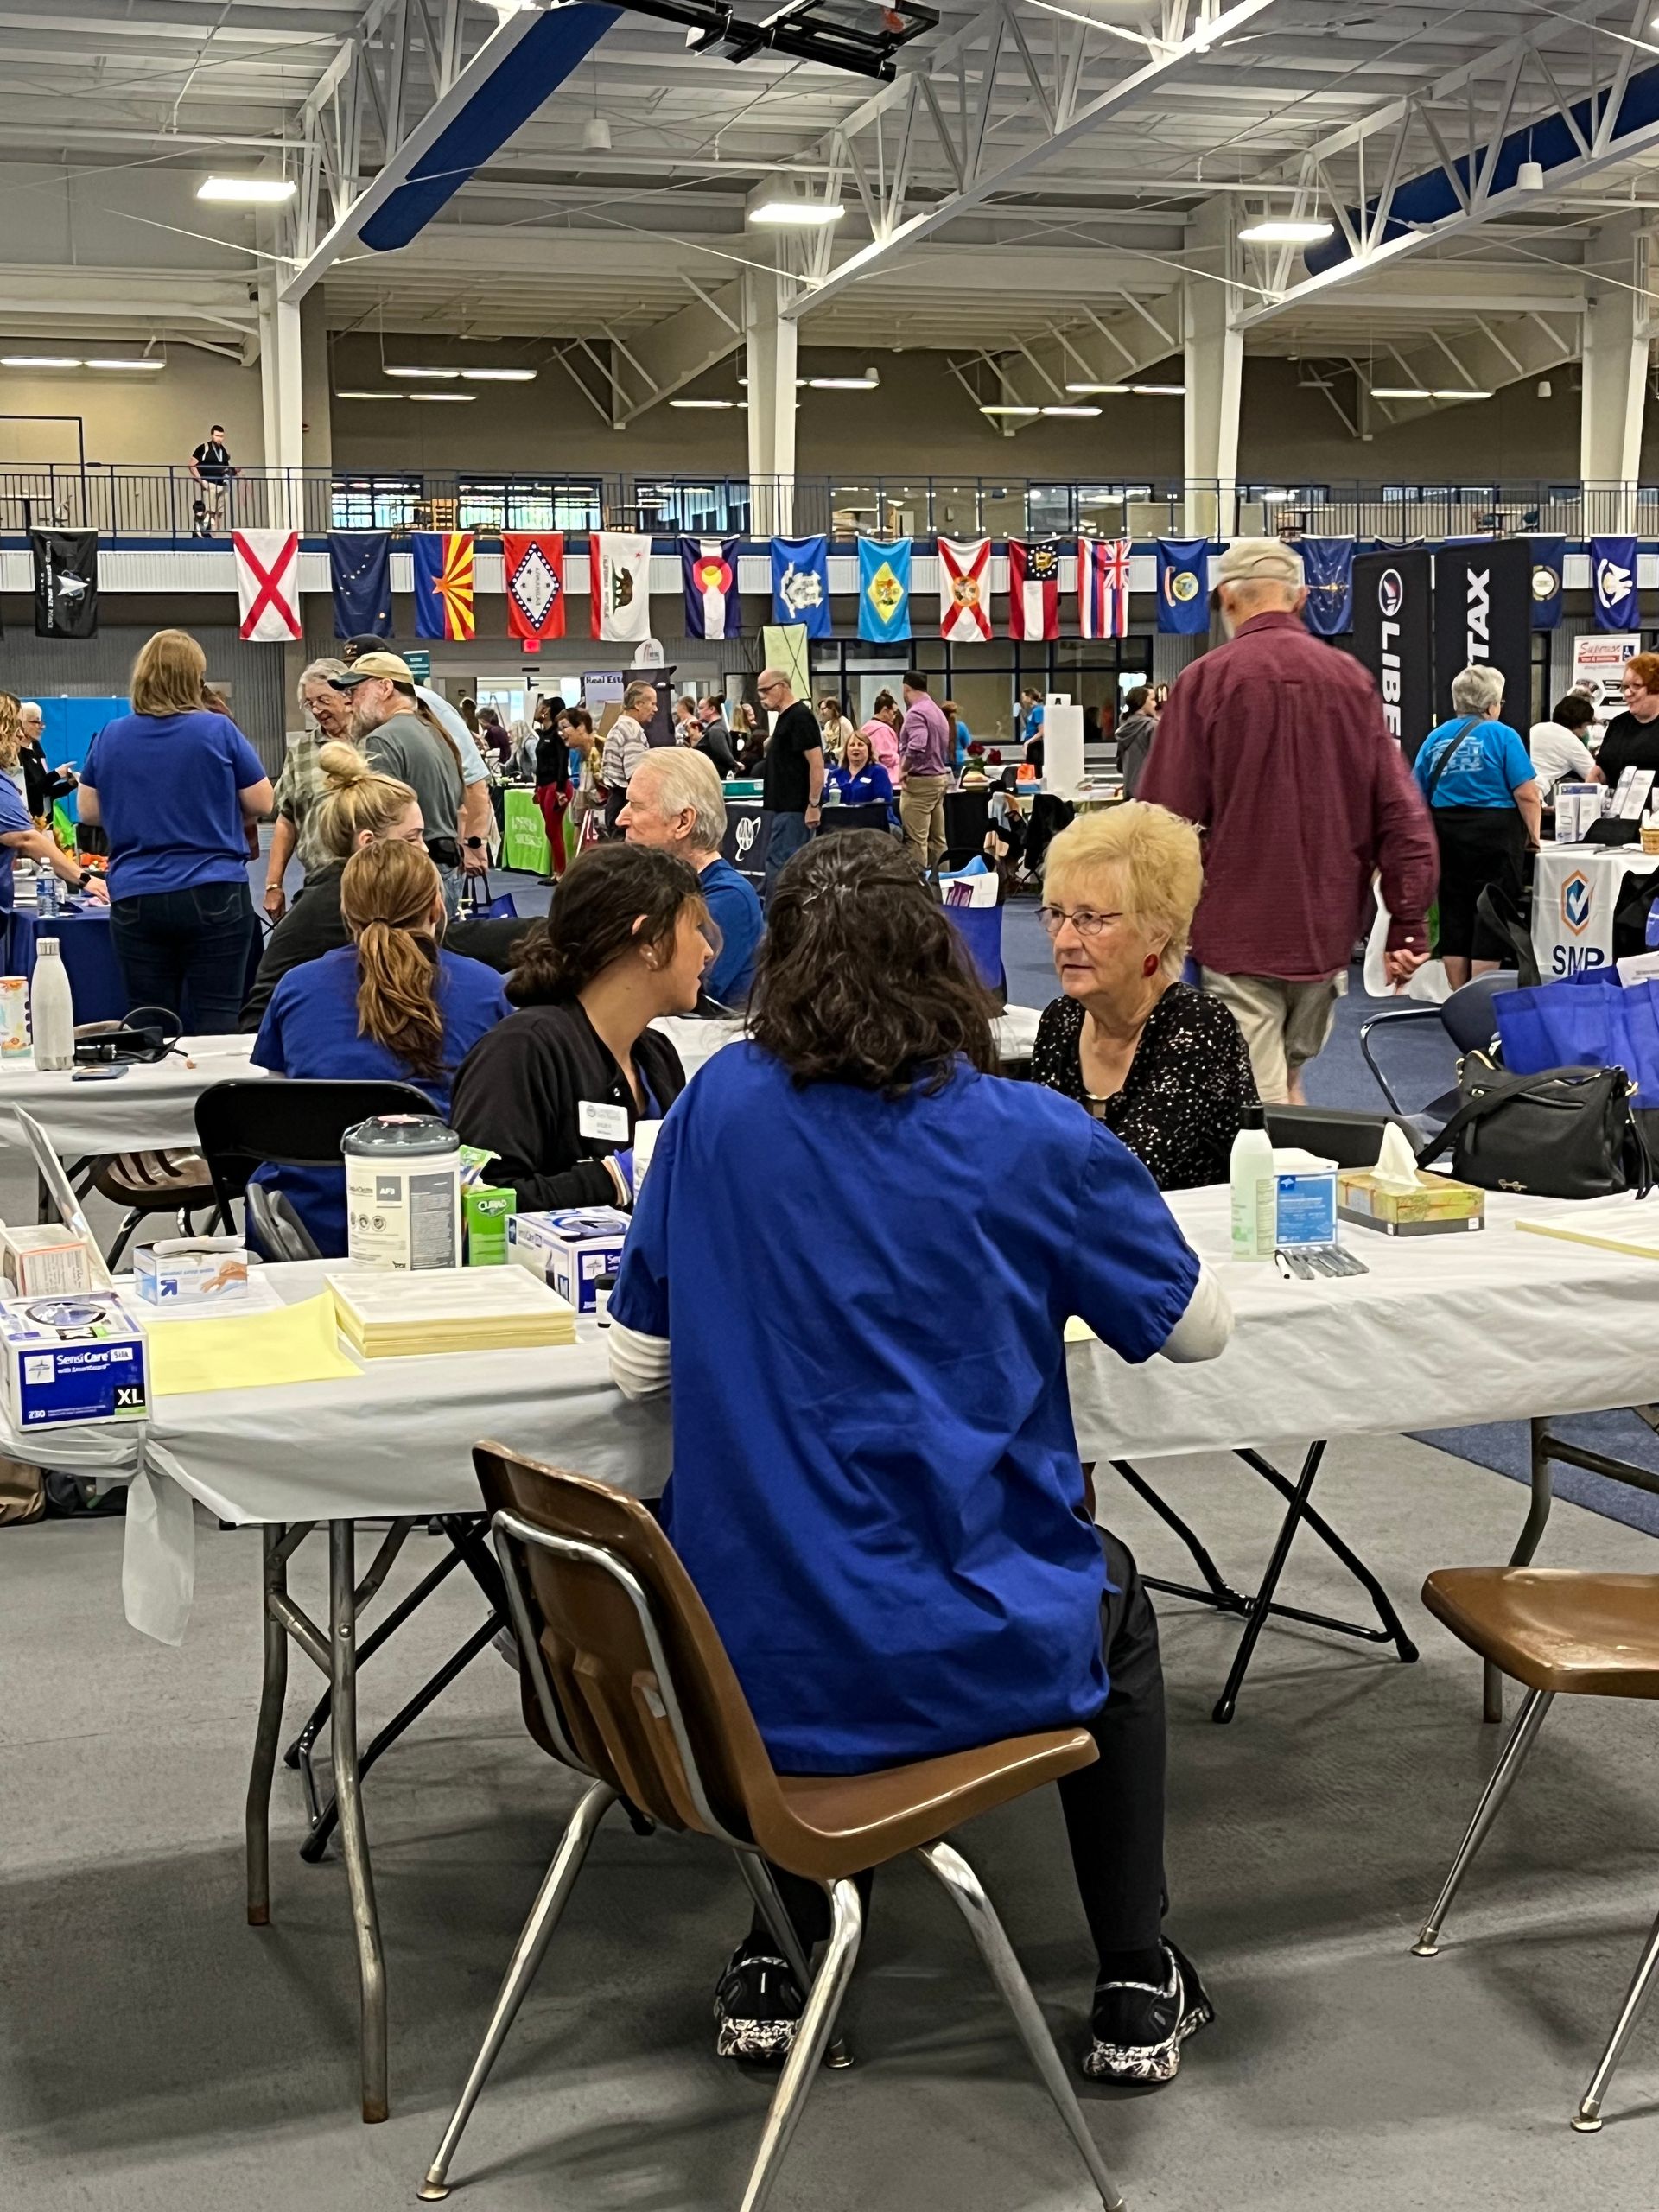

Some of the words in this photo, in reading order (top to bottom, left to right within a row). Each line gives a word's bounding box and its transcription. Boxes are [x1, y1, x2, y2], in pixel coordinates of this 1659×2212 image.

[1467, 569, 1490, 664] TAX
[586, 676, 605, 684] Real
[1552, 945, 1605, 976] SMP
[56, 1352, 109, 1365] SensiCare
[118, 1388, 143, 1406] XL
